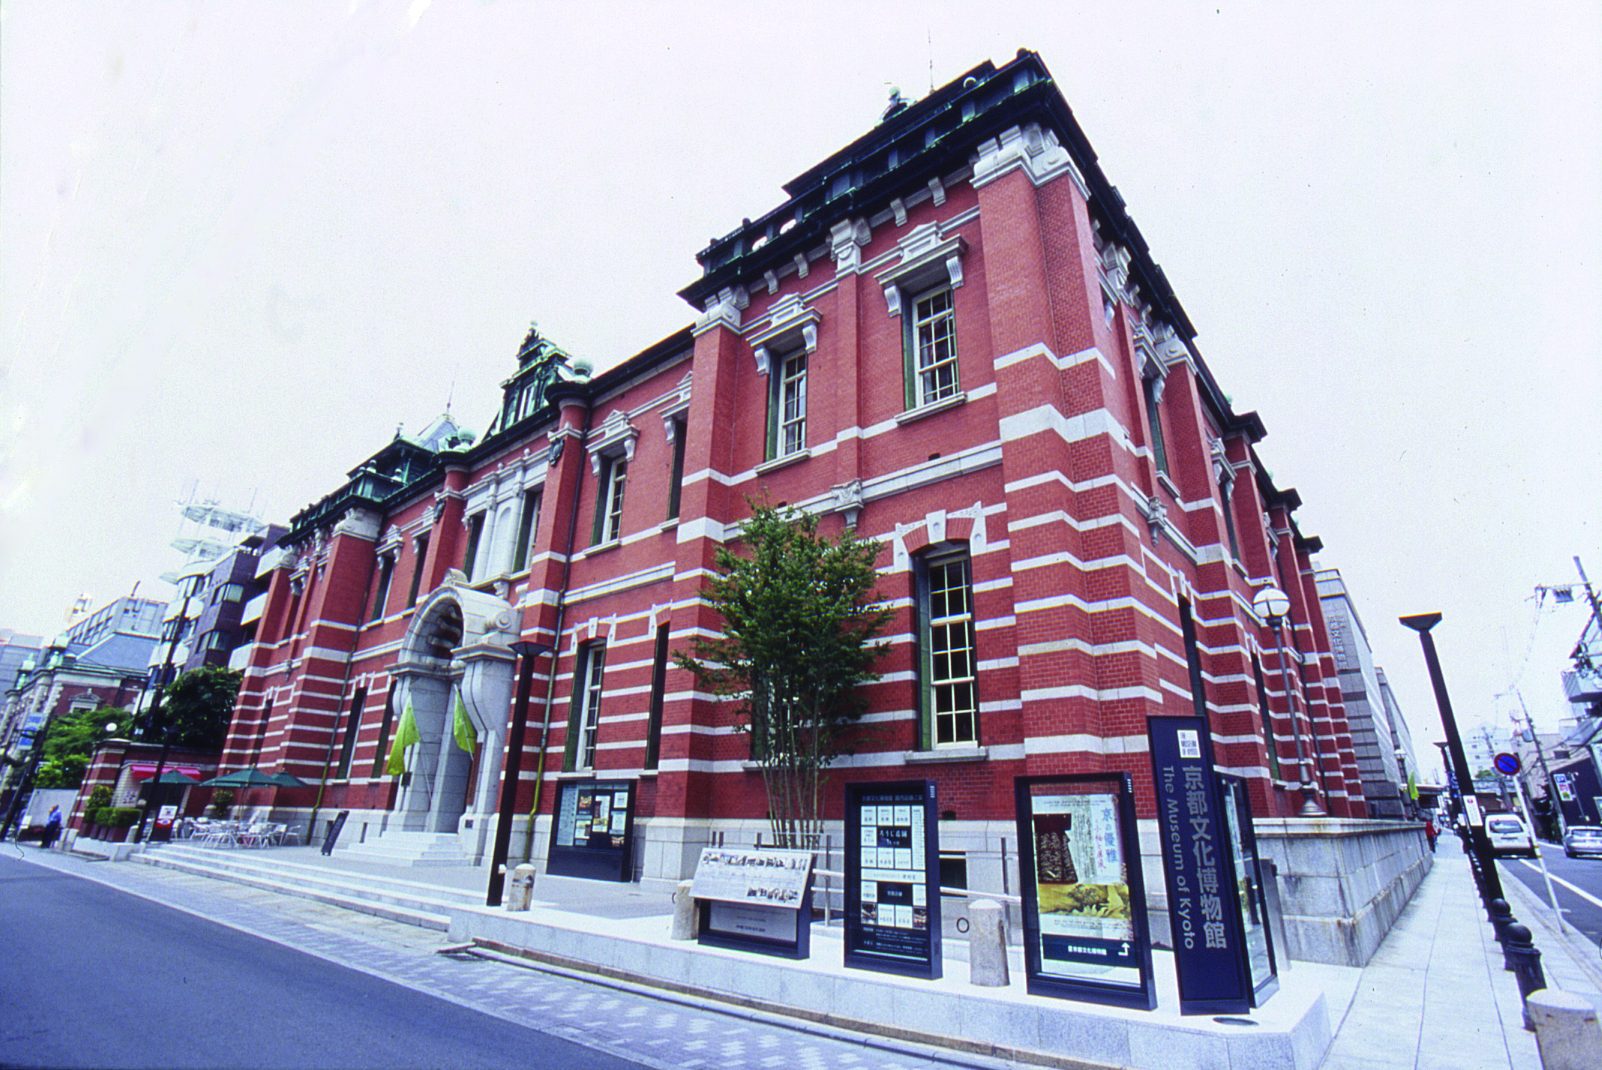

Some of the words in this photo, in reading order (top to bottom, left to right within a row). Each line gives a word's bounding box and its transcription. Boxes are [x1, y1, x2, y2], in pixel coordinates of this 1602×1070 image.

[1162, 765, 1175, 794] The
[1166, 798, 1184, 870] Museum
[1182, 765, 1227, 949] 京都文化博物館
[1176, 875, 1190, 893] of
[1178, 897, 1195, 950] Kyoto
